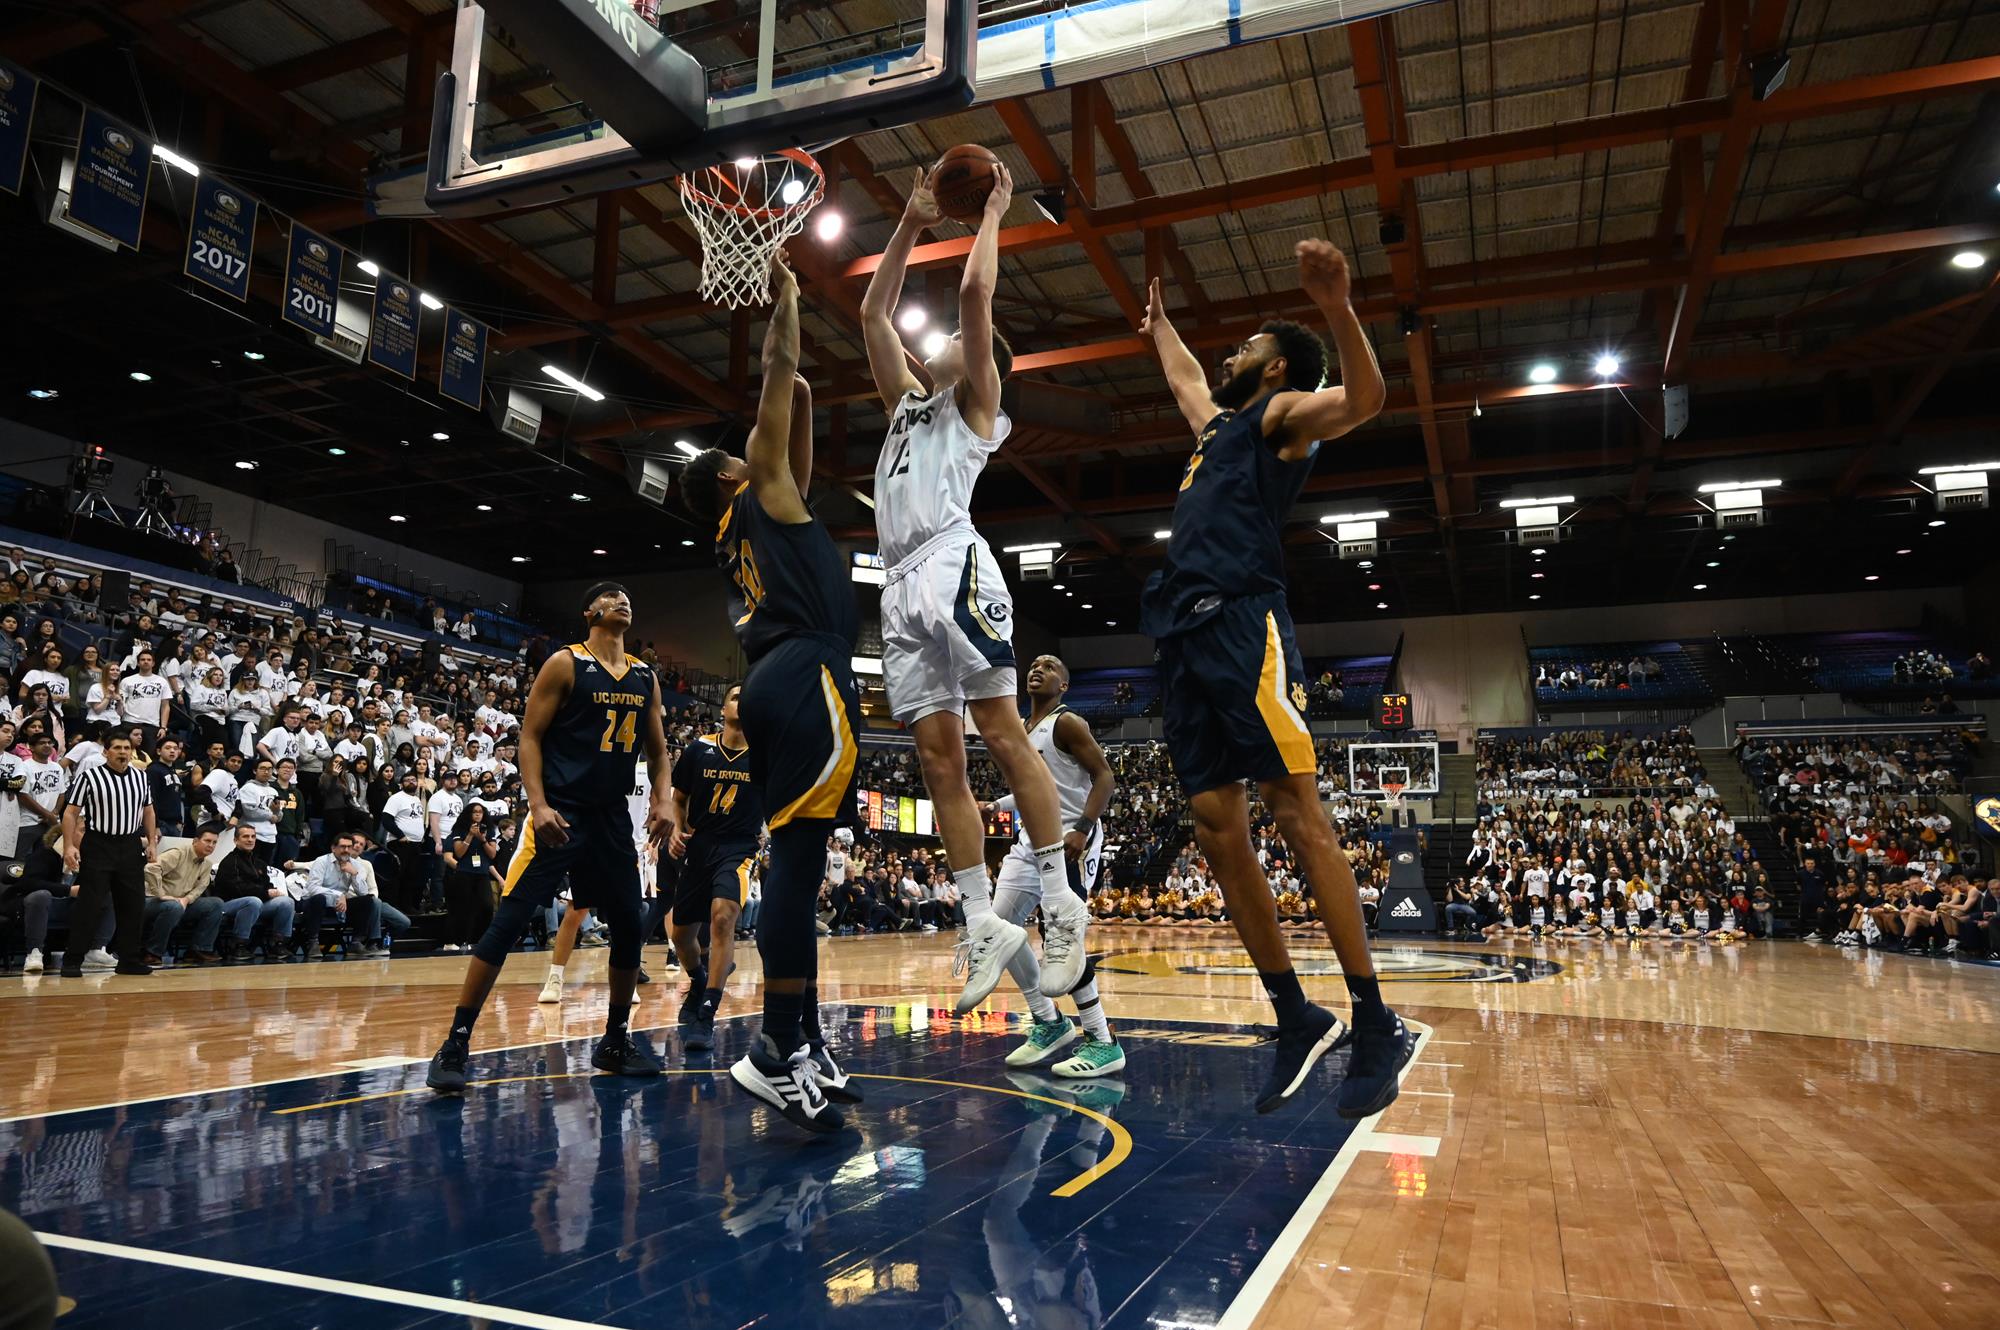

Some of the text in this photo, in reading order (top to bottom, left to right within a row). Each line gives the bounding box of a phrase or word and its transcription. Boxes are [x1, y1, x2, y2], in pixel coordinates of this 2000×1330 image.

[587, 0, 640, 57] ING
[91, 162, 134, 189] TOURNAMENT
[196, 229, 247, 258] TOURNAMENT
[208, 225, 237, 248] NCAA
[192, 240, 247, 279] 2017
[292, 277, 335, 302] TOURNAMENT
[301, 273, 326, 292] NCAA
[290, 287, 333, 324] 2011
[322, 608, 333, 616] 224
[592, 691, 645, 708] UC IRVINE
[1383, 696, 1407, 706] 9:19
[1382, 706, 1403, 724] 23
[599, 709, 637, 753] 24
[703, 768, 751, 783] UC IRVINE
[708, 783, 739, 815] 14
[1391, 909, 1422, 917] adidas
